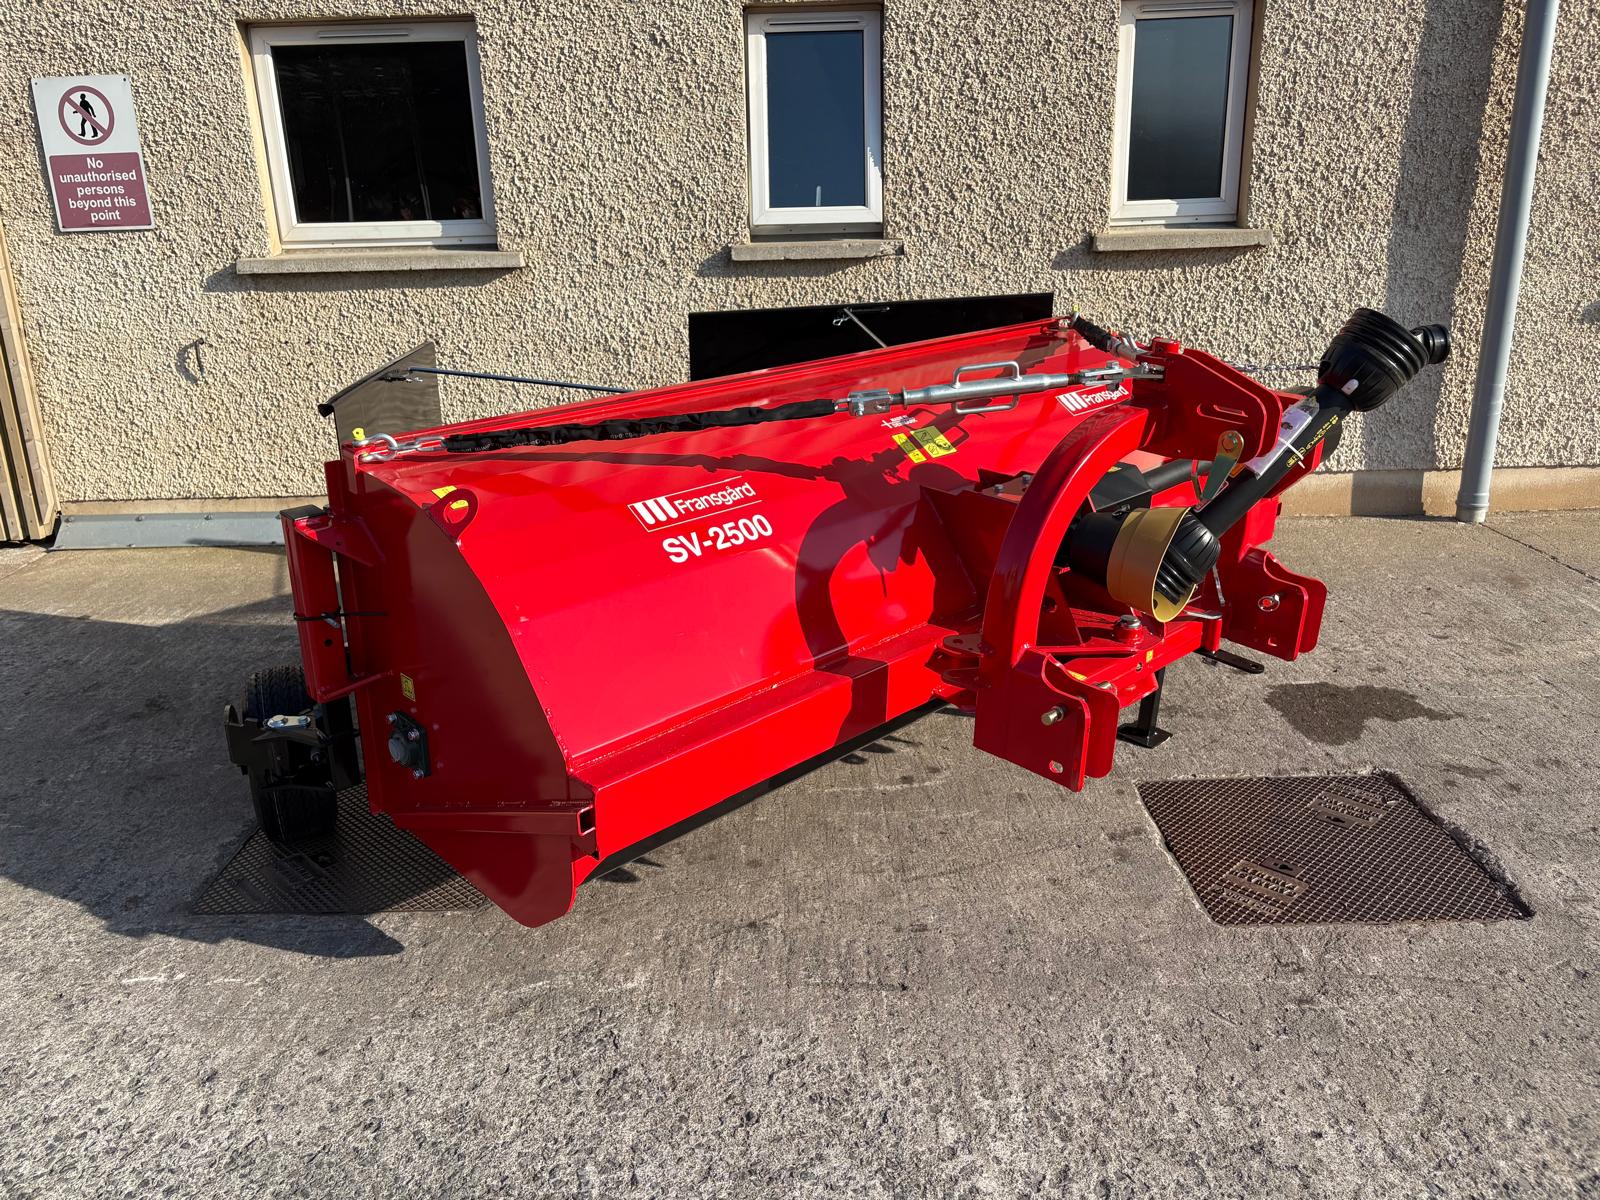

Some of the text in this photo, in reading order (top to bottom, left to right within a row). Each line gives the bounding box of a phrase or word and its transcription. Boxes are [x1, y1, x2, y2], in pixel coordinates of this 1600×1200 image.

[86, 157, 104, 169] No
[59, 170, 137, 183] unauthorised
[77, 185, 124, 197] persons
[69, 196, 136, 210] beyond this
[91, 210, 121, 222] point
[674, 482, 756, 514] Fransgård
[662, 514, 773, 563] SV-2500
